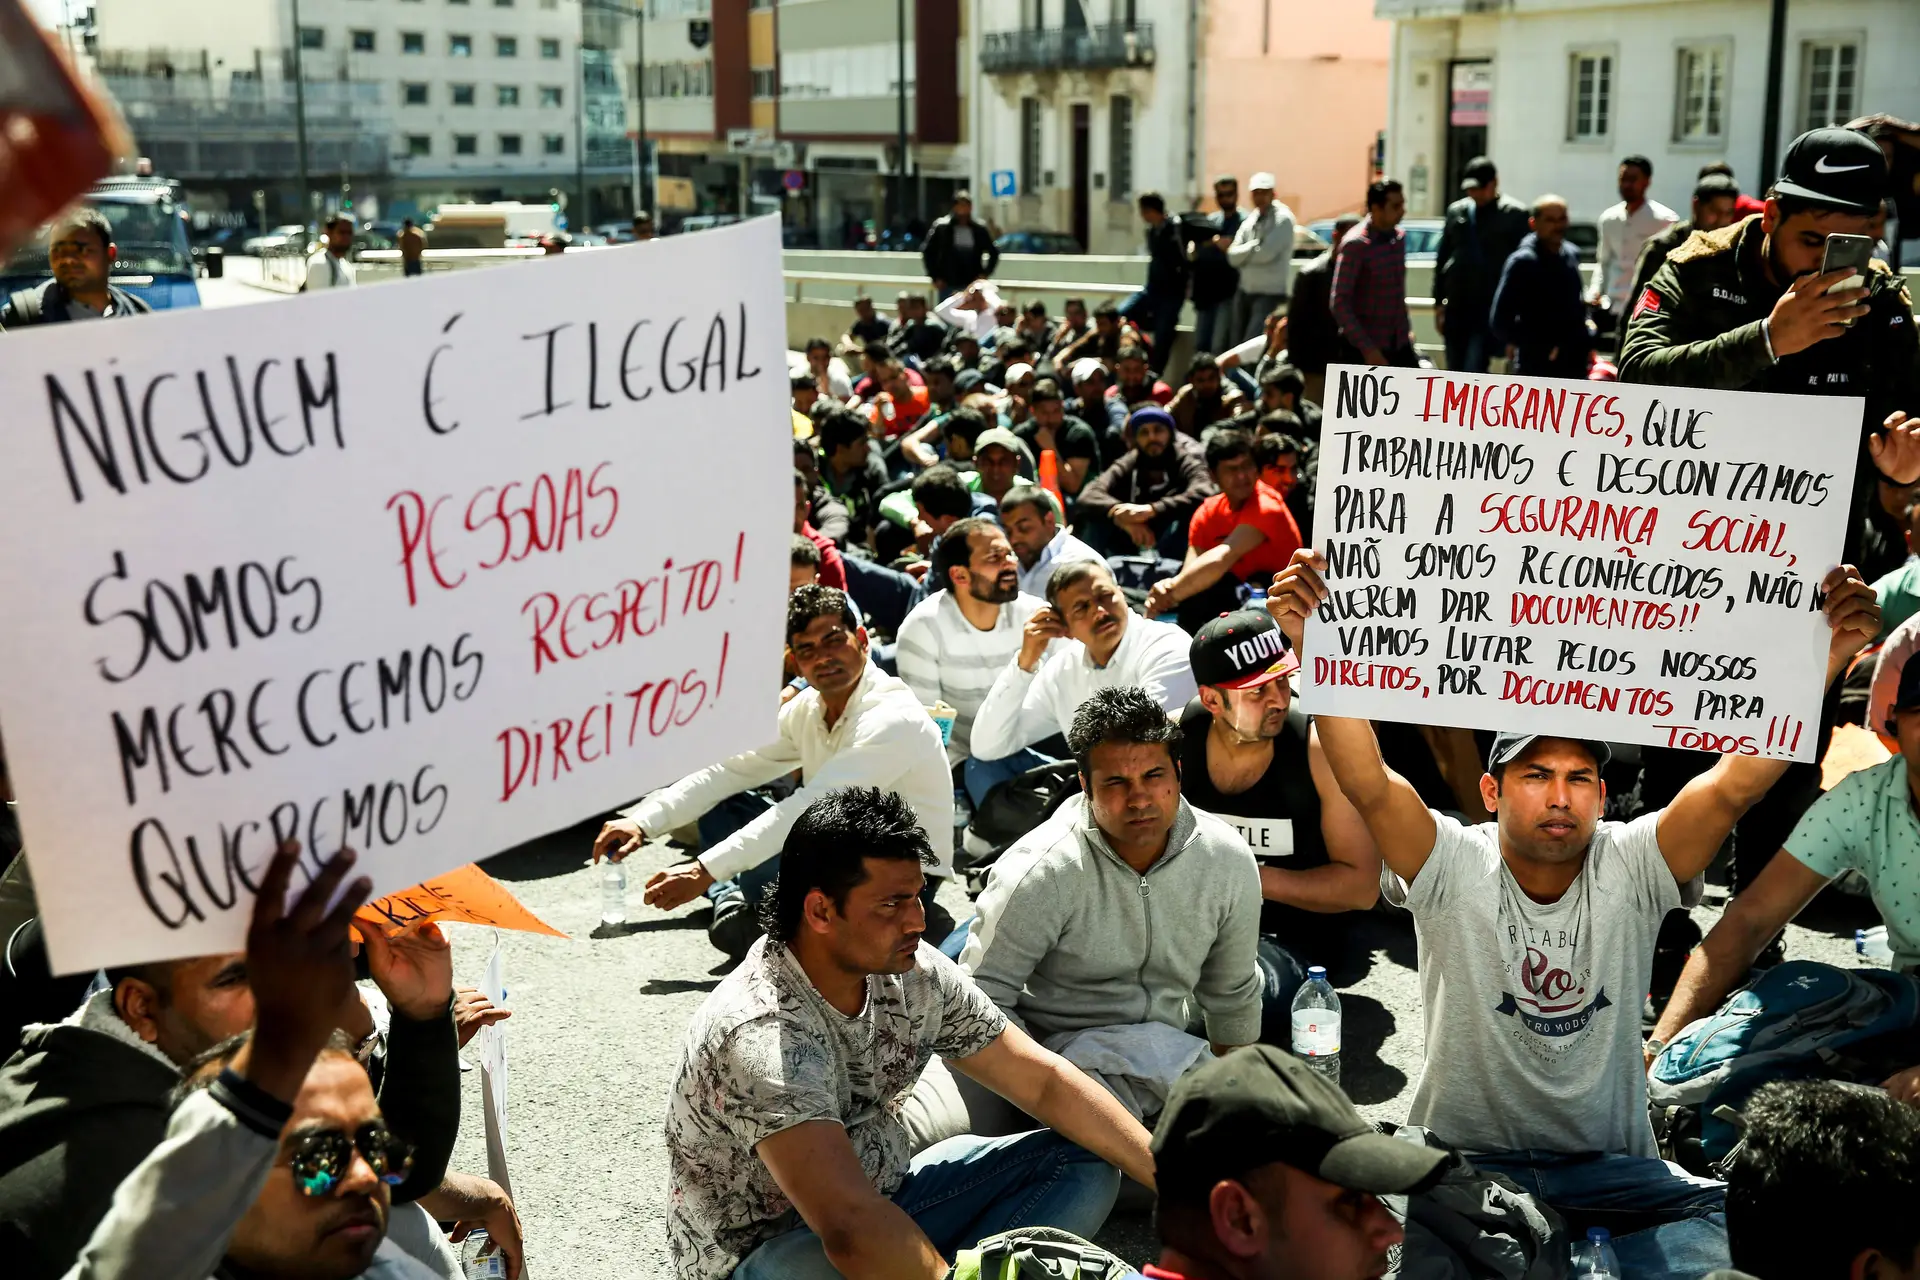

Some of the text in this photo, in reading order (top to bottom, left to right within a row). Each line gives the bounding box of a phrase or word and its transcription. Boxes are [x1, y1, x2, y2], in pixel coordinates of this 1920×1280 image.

[44, 303, 763, 503] NIGUEM É ILEGAL
[1335, 366, 1713, 450] NÓS IMIGRANTES, QUE
[1334, 430, 1835, 507] TRABALHAMOS E DESCONTAMOS
[1333, 484, 1408, 535] PARA
[1434, 493, 1454, 536] A
[1681, 509, 1798, 568] SOCIAL,
[1404, 543, 1496, 581] SOMOS
[83, 462, 619, 684] SOMOS PESSOAS
[1317, 584, 1702, 633] QUEREM DAR DOCUMENTOS!!
[110, 530, 746, 808] MERECEMOS RESPEITO!
[1313, 654, 1766, 721] DIREITOS, POR DOCUMENTOS PARA
[1337, 625, 1758, 682] VAMOS LUTAR PELOS NOSSOS
[1652, 713, 1804, 758] TODOS!!!
[127, 631, 731, 930] QUEREMOS DIREITOS!
